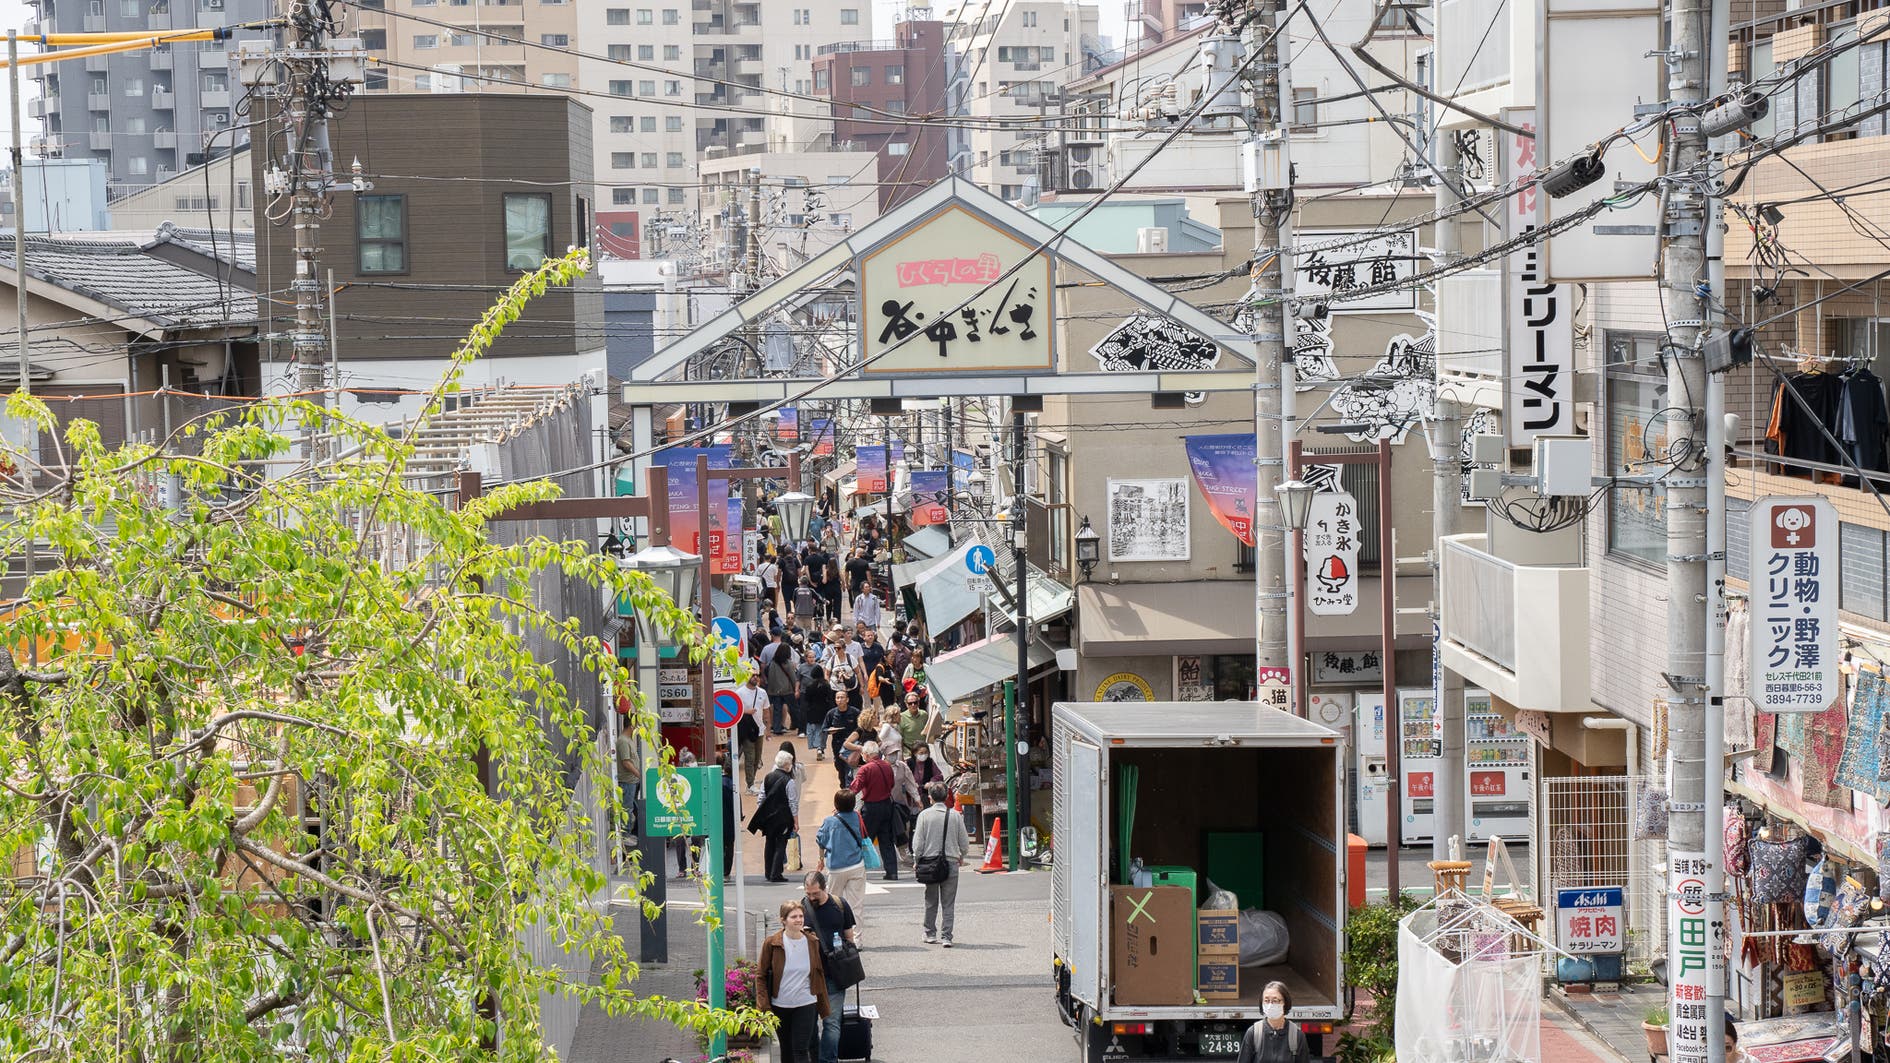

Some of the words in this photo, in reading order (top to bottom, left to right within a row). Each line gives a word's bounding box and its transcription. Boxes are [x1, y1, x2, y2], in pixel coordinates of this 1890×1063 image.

[899, 253, 998, 284] ひぐらしの里
[1303, 249, 1397, 290] 後藤の飴
[878, 277, 1037, 357] 谷中ぎんざ
[1335, 502, 1352, 552] かき氷
[1313, 594, 1353, 606] ひみつ堂
[1767, 552, 1791, 668] クリニック
[1794, 551, 1820, 669] 動物・野澤
[1765, 671, 1823, 681] セレス千代田21前
[1765, 683, 1823, 693] 西日暮里6-56-3
[1271, 689, 1287, 711] 猫
[1765, 694, 1823, 704] 3894-7739
[1574, 892, 1608, 907] Asahi
[1569, 915, 1617, 938] 焼肉
[1569, 941, 1617, 950] サラリーマン
[1675, 983, 1707, 1000] 新客歓
[1208, 1041, 1241, 1053] 24-89
